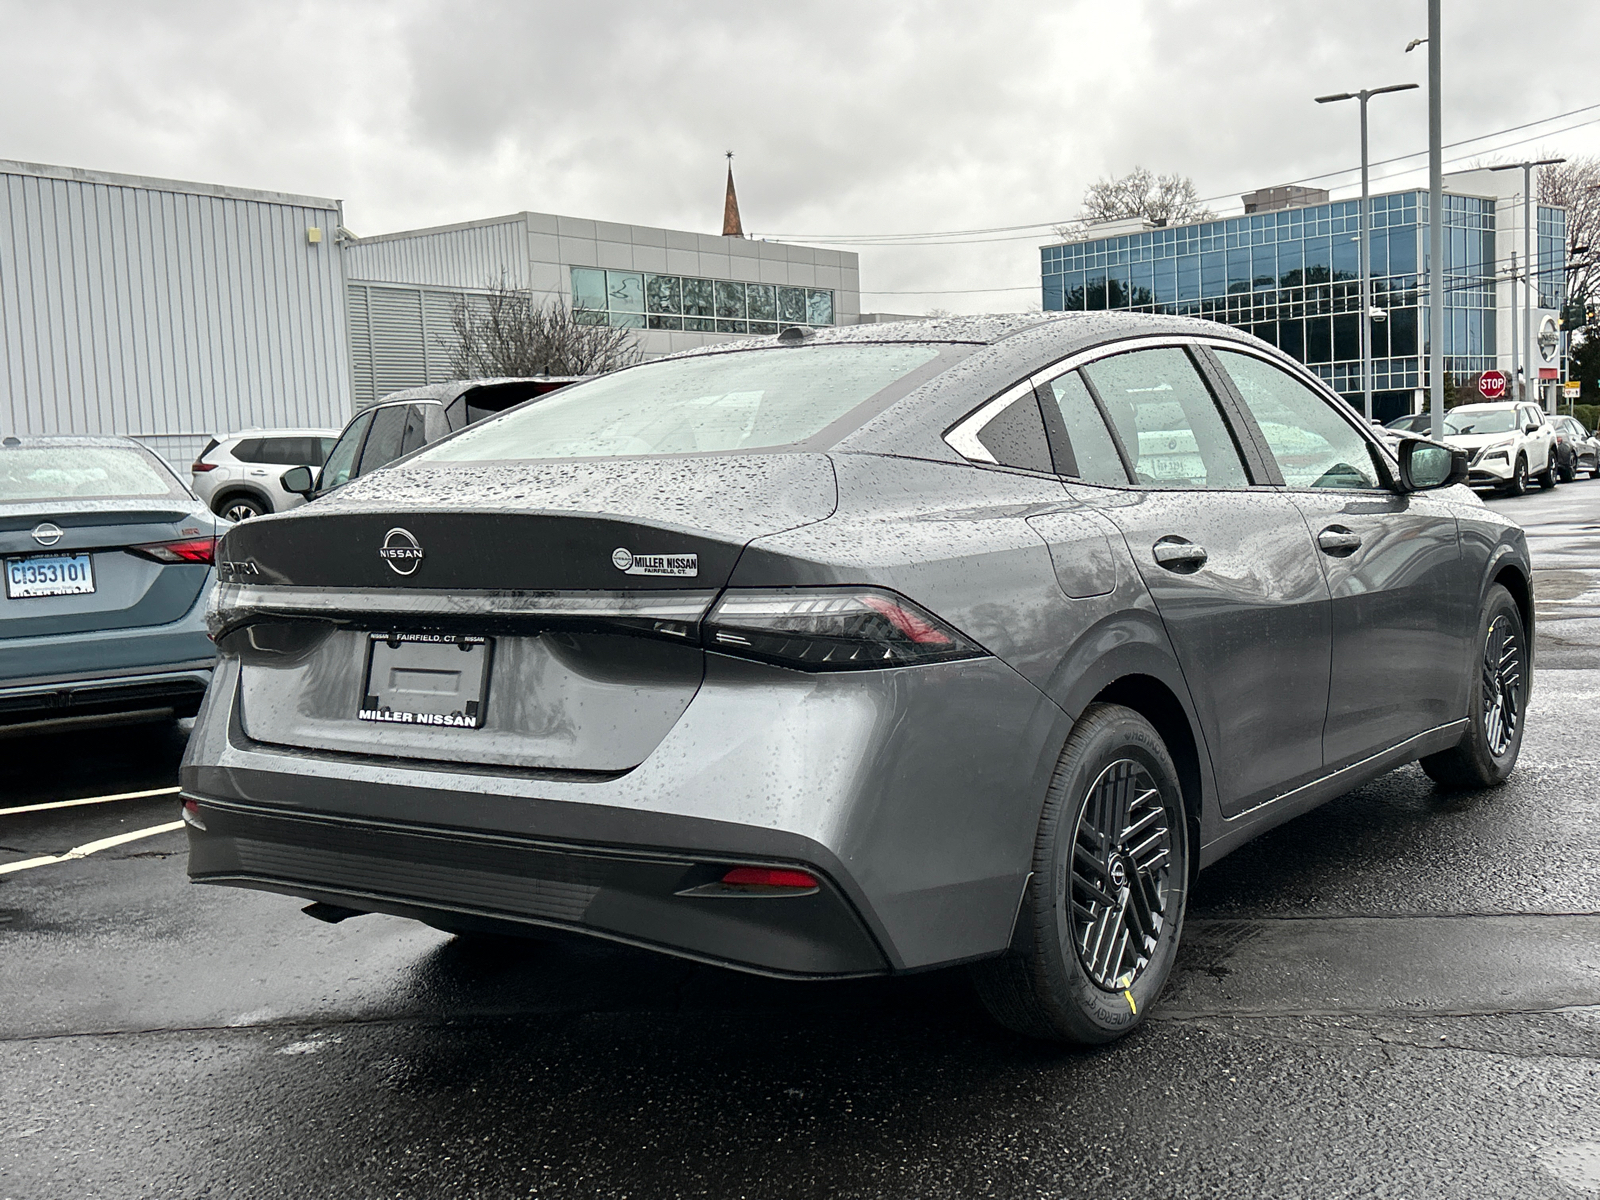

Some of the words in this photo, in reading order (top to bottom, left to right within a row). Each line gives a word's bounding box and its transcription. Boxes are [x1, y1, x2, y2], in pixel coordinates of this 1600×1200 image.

[1481, 378, 1504, 390] STOP
[380, 549, 423, 558] NISSAN
[634, 557, 664, 568] MILLER
[666, 559, 697, 569] NISSAN
[396, 633, 442, 643] FAIRFIELD,
[443, 634, 457, 642] CT
[359, 709, 413, 723] MILLER
[416, 713, 476, 728] NISSAN
